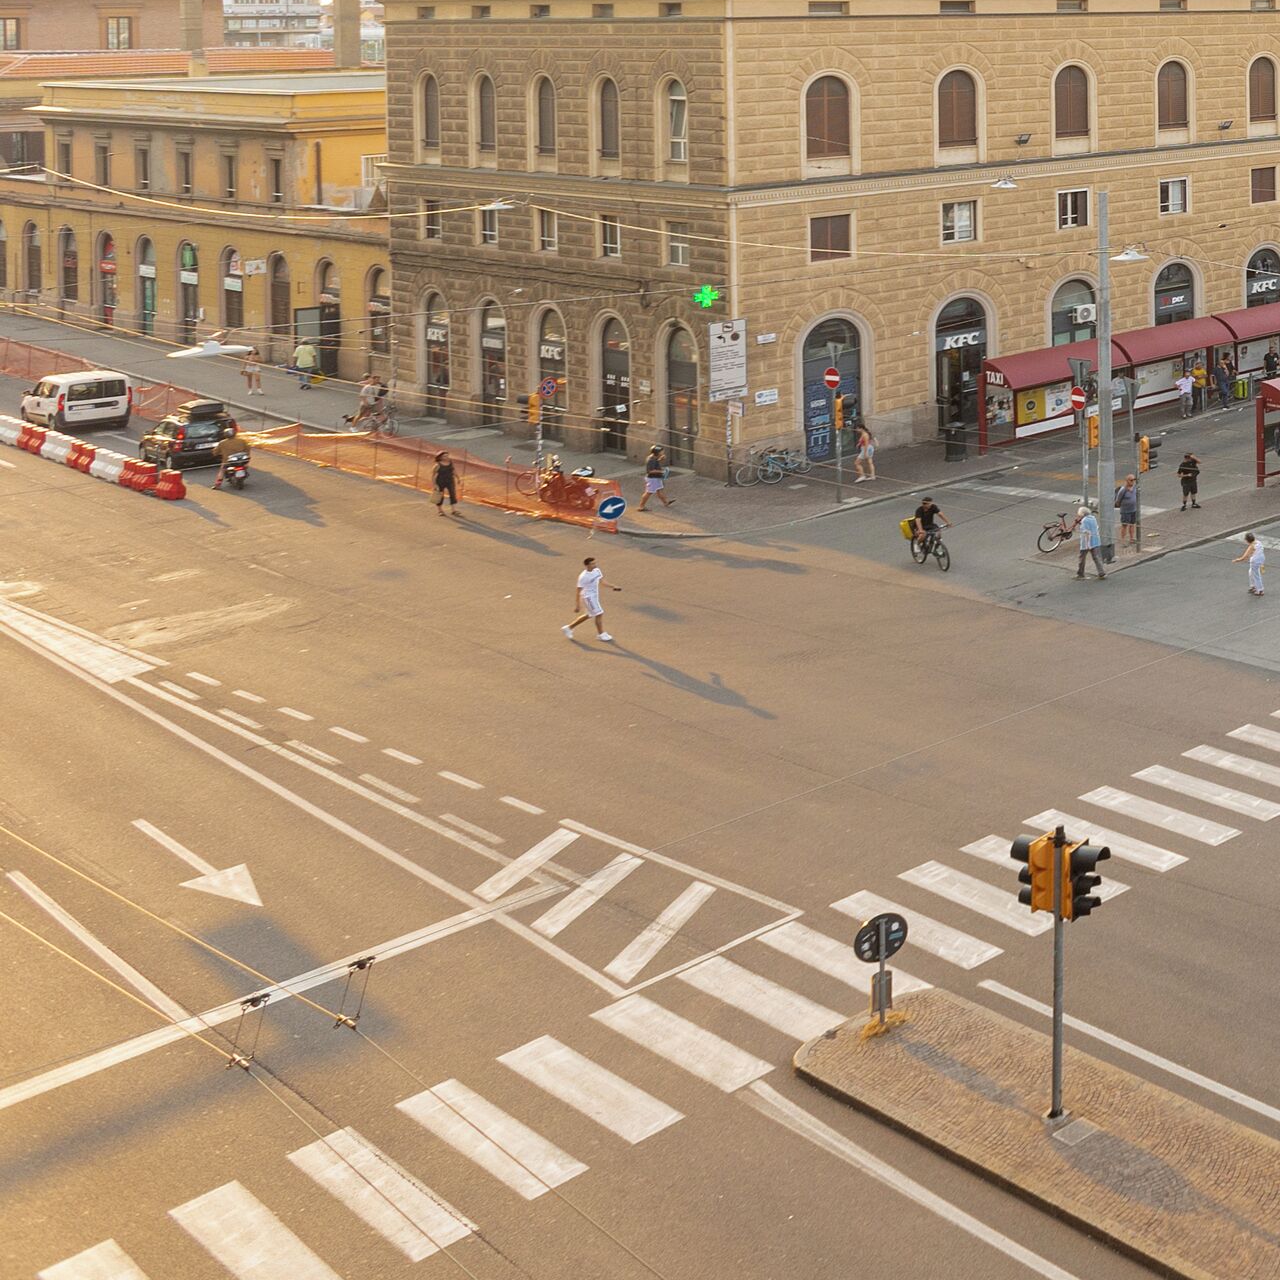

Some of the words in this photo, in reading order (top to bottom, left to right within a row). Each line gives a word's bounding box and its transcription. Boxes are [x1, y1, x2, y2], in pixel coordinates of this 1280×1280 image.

[1251, 279, 1278, 293] KFC
[426, 327, 447, 342] KFC
[943, 331, 981, 350] KFC
[540, 344, 563, 360] KFC
[985, 370, 1004, 385] TAXI
